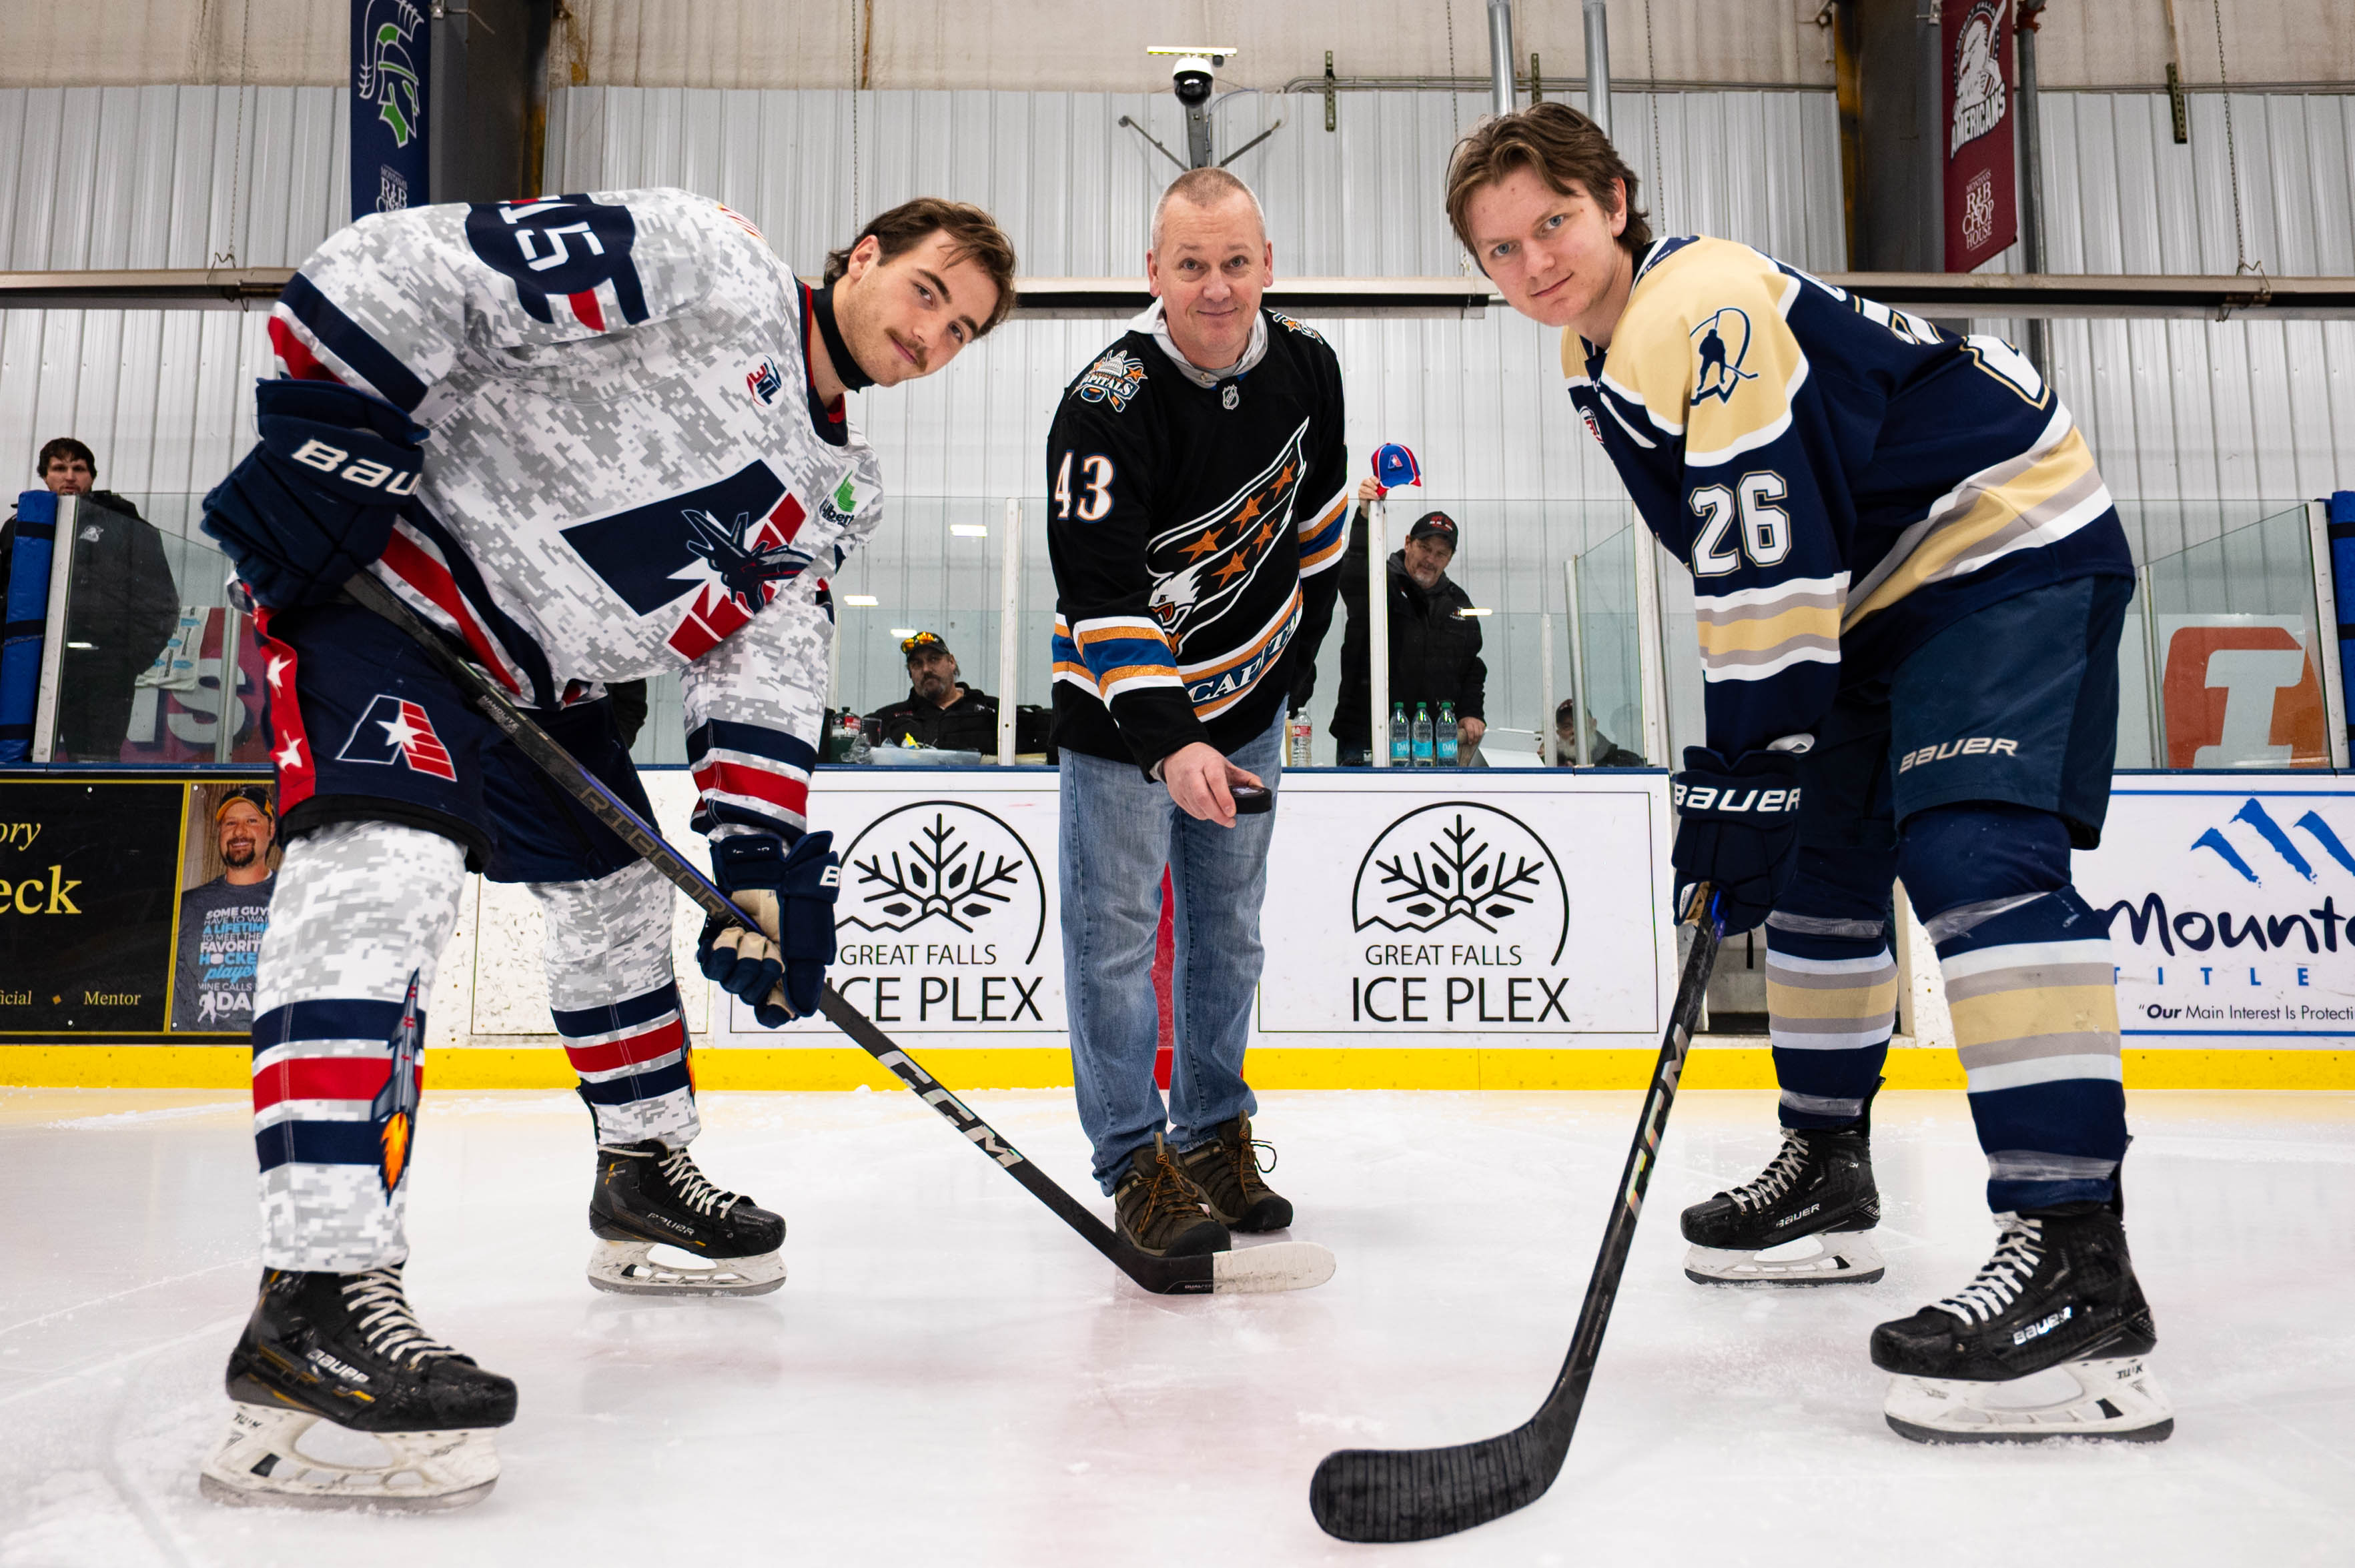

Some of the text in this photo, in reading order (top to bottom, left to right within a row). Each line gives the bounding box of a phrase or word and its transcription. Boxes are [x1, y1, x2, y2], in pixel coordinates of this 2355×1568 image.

[1951, 81, 2006, 160] AMERICANS
[1966, 221, 1992, 249] HOUSE
[1053, 449, 1117, 523] 43
[1689, 470, 1792, 578] 26
[1899, 737, 2019, 775] BAUER
[1675, 784, 1801, 812] BAUER
[578, 786, 727, 920] RIBCOR
[203, 914, 268, 926] HAVE TO WAI
[205, 907, 240, 920] SOME
[2107, 892, 2355, 957] Mount
[202, 934, 214, 942] TO
[215, 933, 241, 942] MEET
[203, 924, 212, 934] A
[840, 944, 997, 966] GREAT FALLS
[1365, 944, 1522, 966] GREAT FALLS
[83, 990, 141, 1006] Mentor
[222, 982, 253, 991] CALLS
[825, 976, 1044, 1022] ICE PLEX
[1352, 976, 1571, 1022] ICE PLEX
[2186, 1004, 2224, 1020] Main
[2230, 1004, 2282, 1020] Interest
[2286, 1005, 2296, 1020] Is
[877, 1050, 1025, 1168] CCM
